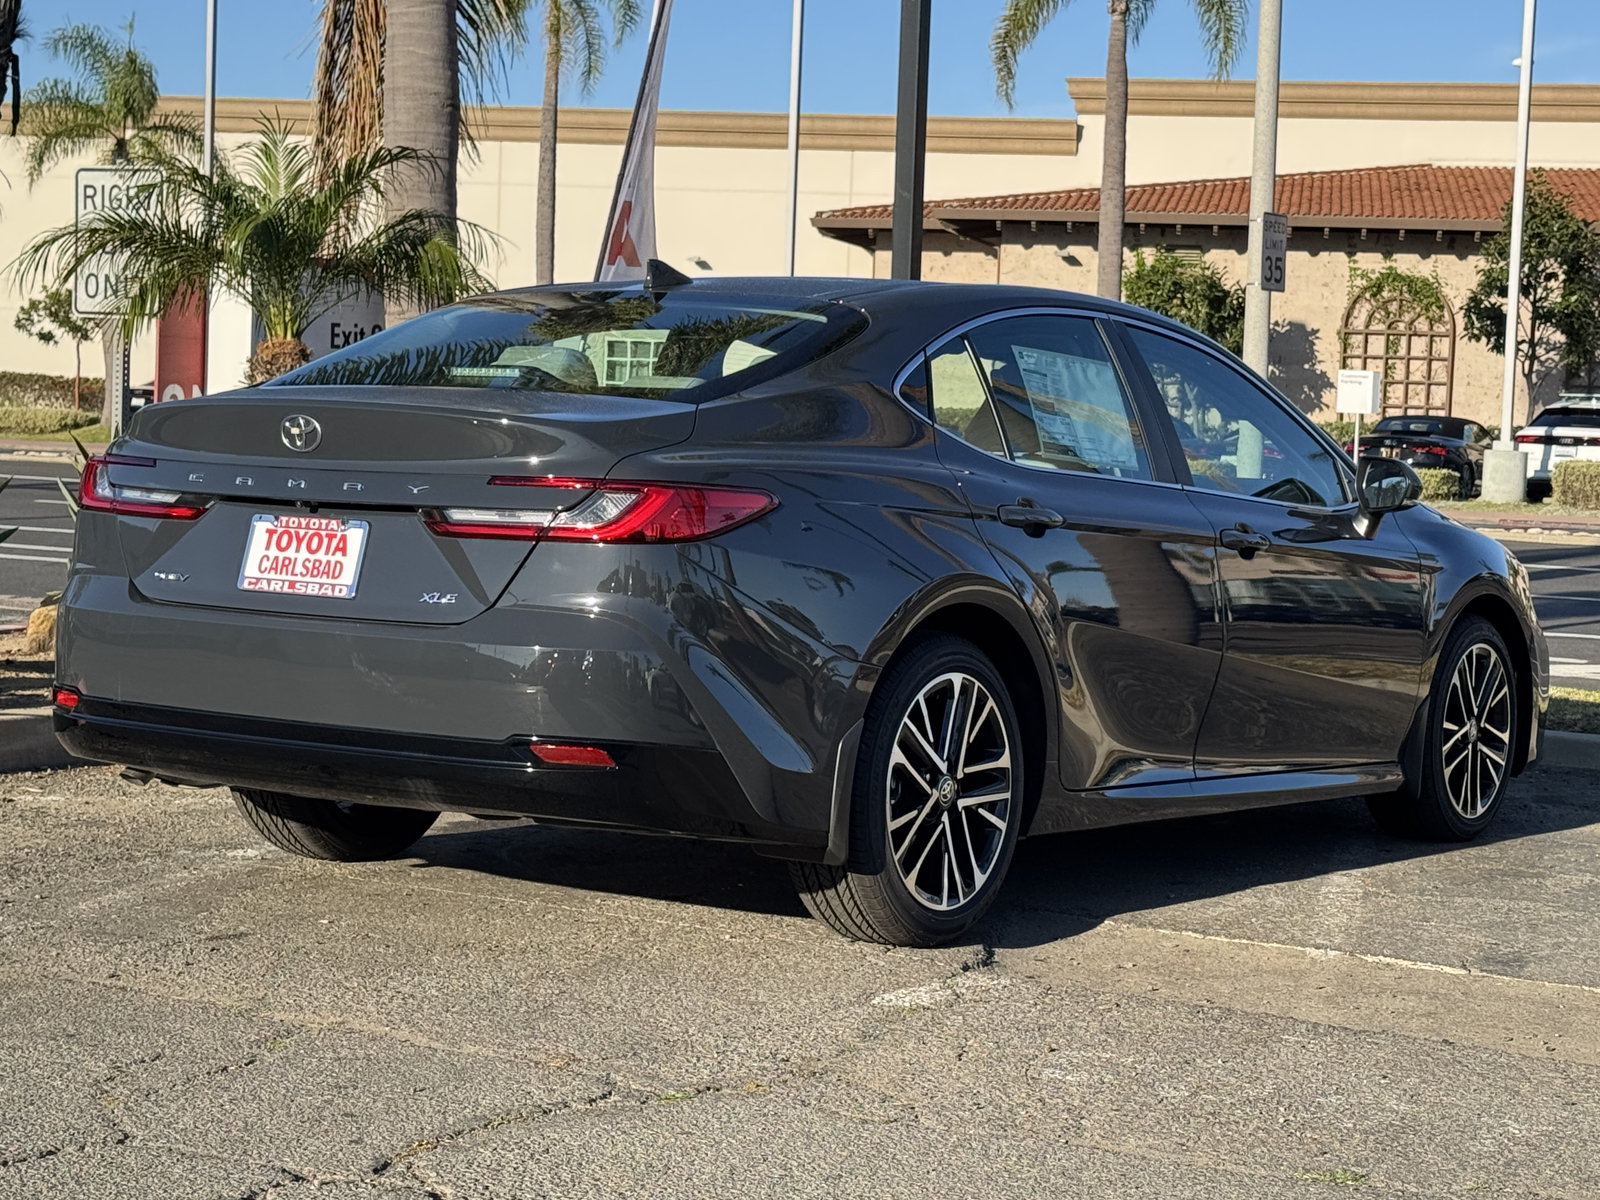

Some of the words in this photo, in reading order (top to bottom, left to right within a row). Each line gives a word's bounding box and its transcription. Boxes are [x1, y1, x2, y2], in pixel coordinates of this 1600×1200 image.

[1263, 220, 1286, 235] SPEED
[1264, 237, 1284, 251] LIMIT
[1263, 255, 1283, 284] 35
[85, 273, 140, 300] ONL
[330, 322, 366, 349] Exit
[188, 473, 430, 494] CAMRY
[280, 516, 340, 531] TOYOTA
[265, 528, 347, 557] TOYOTA
[258, 554, 344, 580] CARLSBAD
[243, 577, 348, 597] CARLSBAD
[419, 592, 459, 604] XLE
